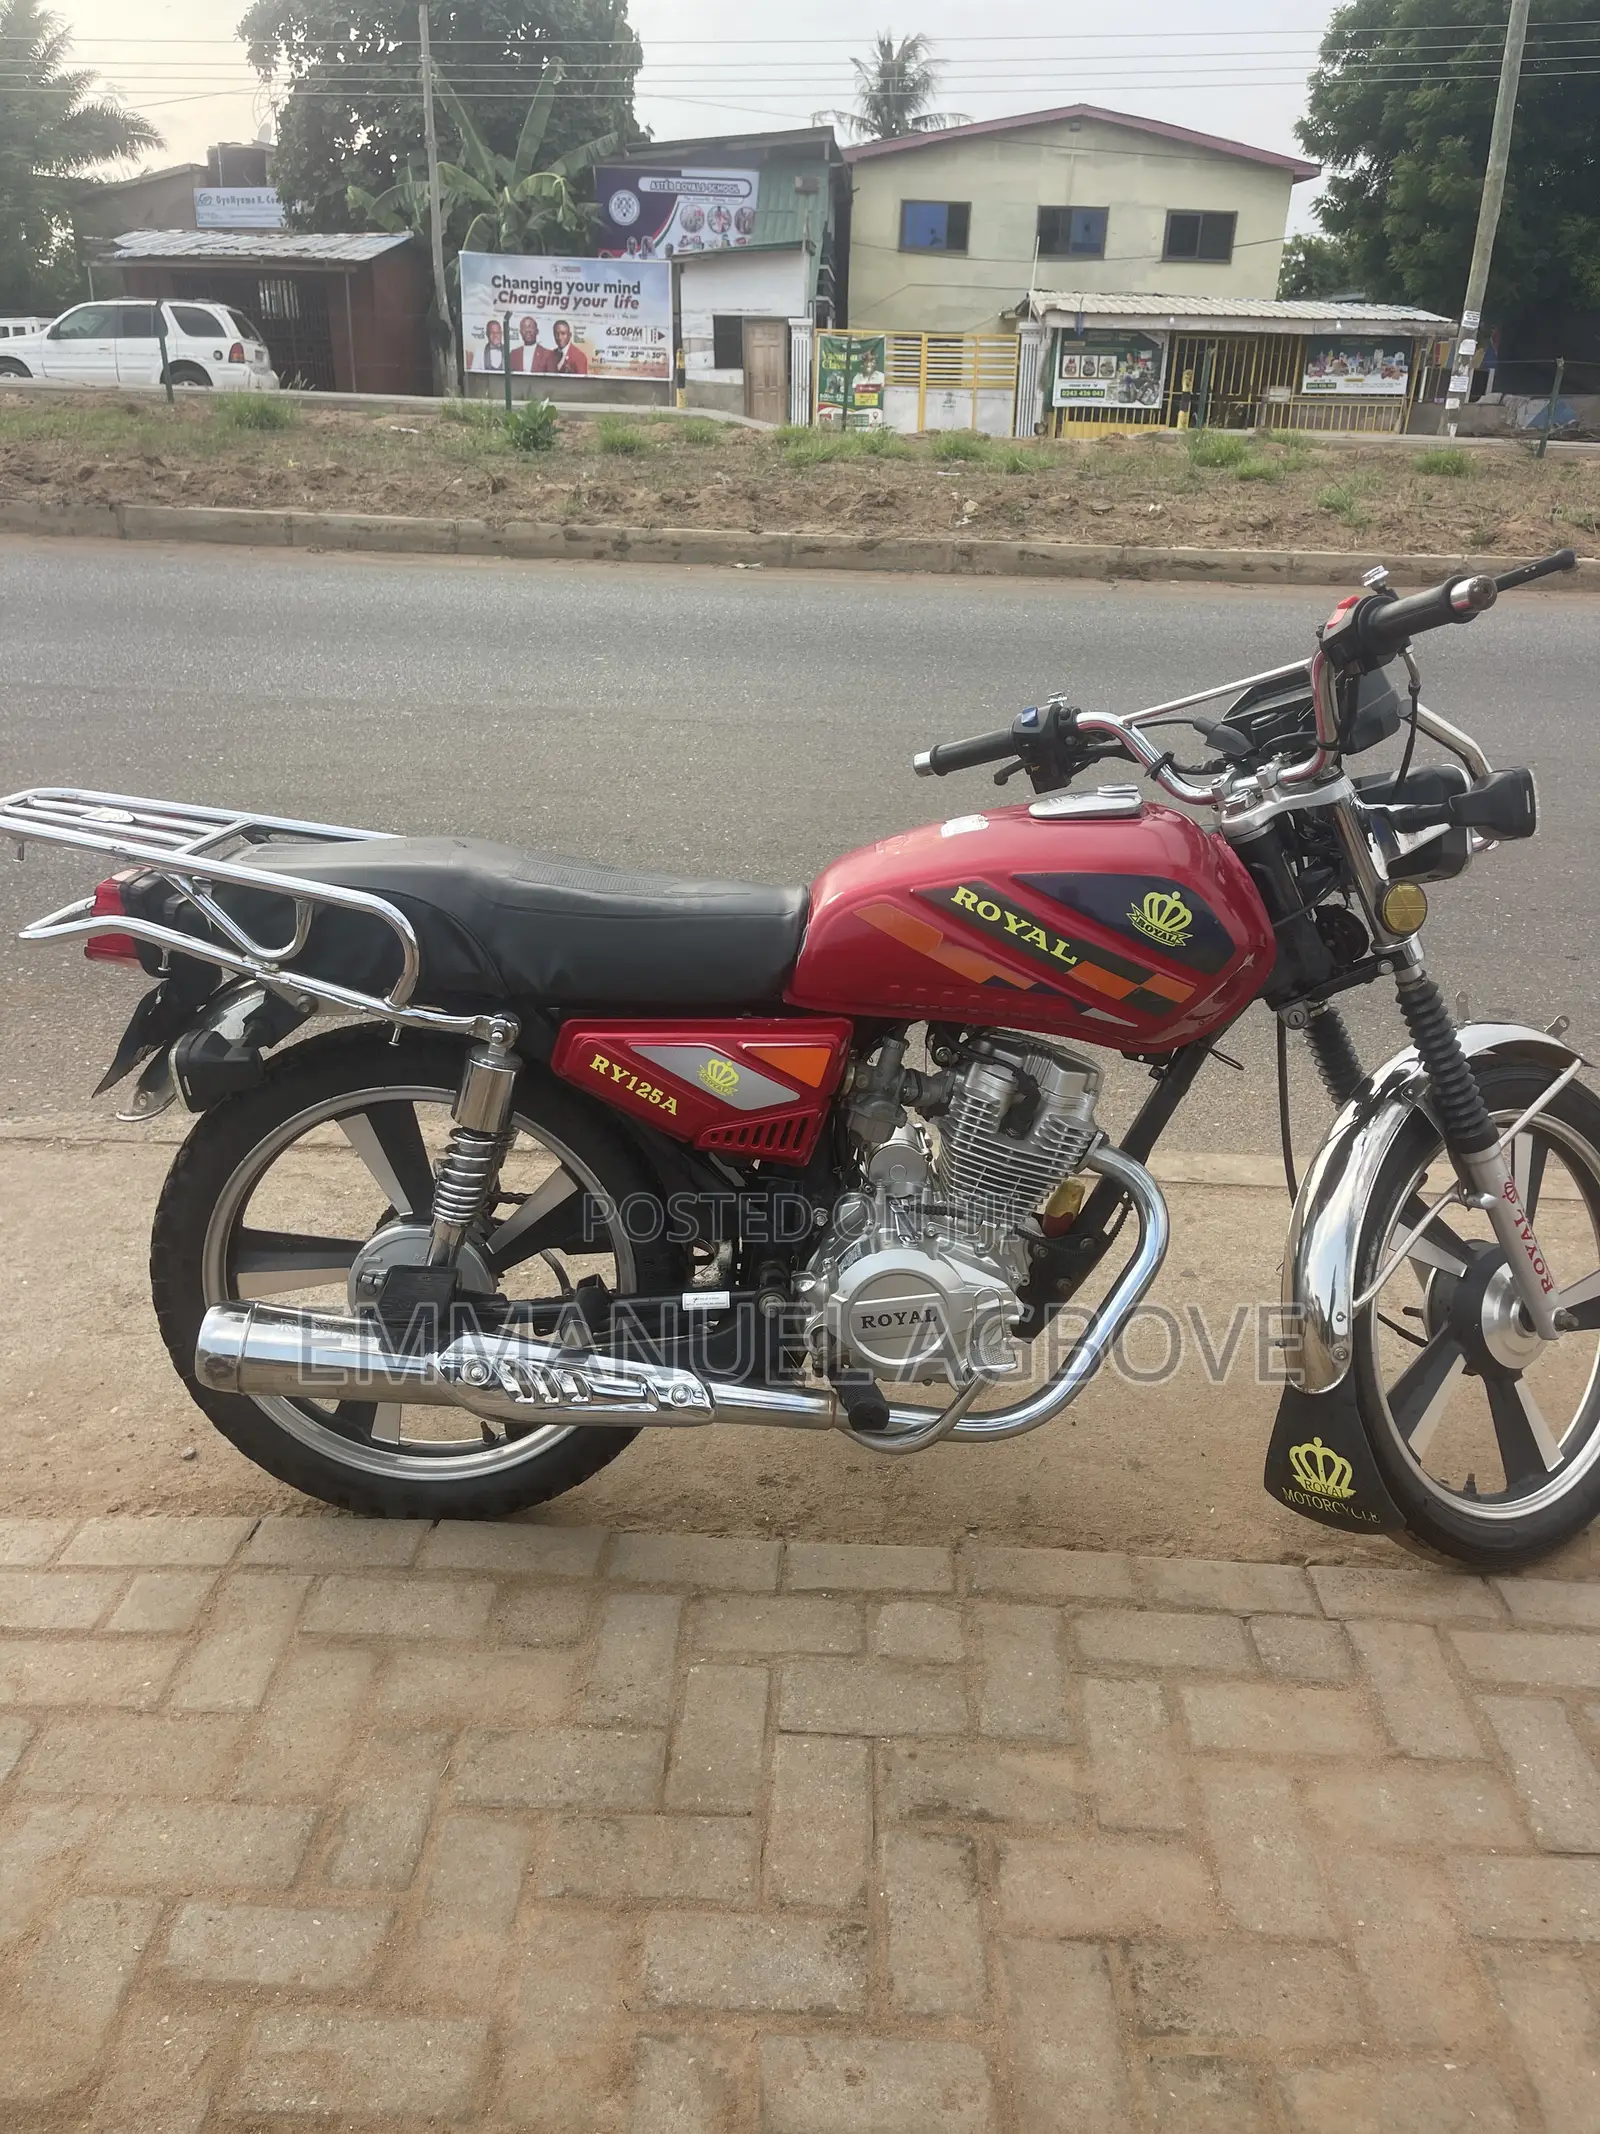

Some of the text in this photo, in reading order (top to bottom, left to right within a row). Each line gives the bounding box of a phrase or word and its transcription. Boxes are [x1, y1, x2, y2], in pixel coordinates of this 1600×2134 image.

[707, 183, 741, 195] SCHOOL
[491, 275, 641, 296] Changing your mind
[572, 294, 608, 311] your
[613, 295, 640, 310] life
[606, 326, 643, 338] 6:30PM
[950, 885, 1078, 964] ROYAL
[1136, 917, 1176, 944] ROYAL
[589, 1053, 678, 1116] RY125A
[1513, 1208, 1554, 1295] ROYAL
[860, 1308, 938, 1329] ROYAL
[1304, 1480, 1345, 1499] ROYAL
